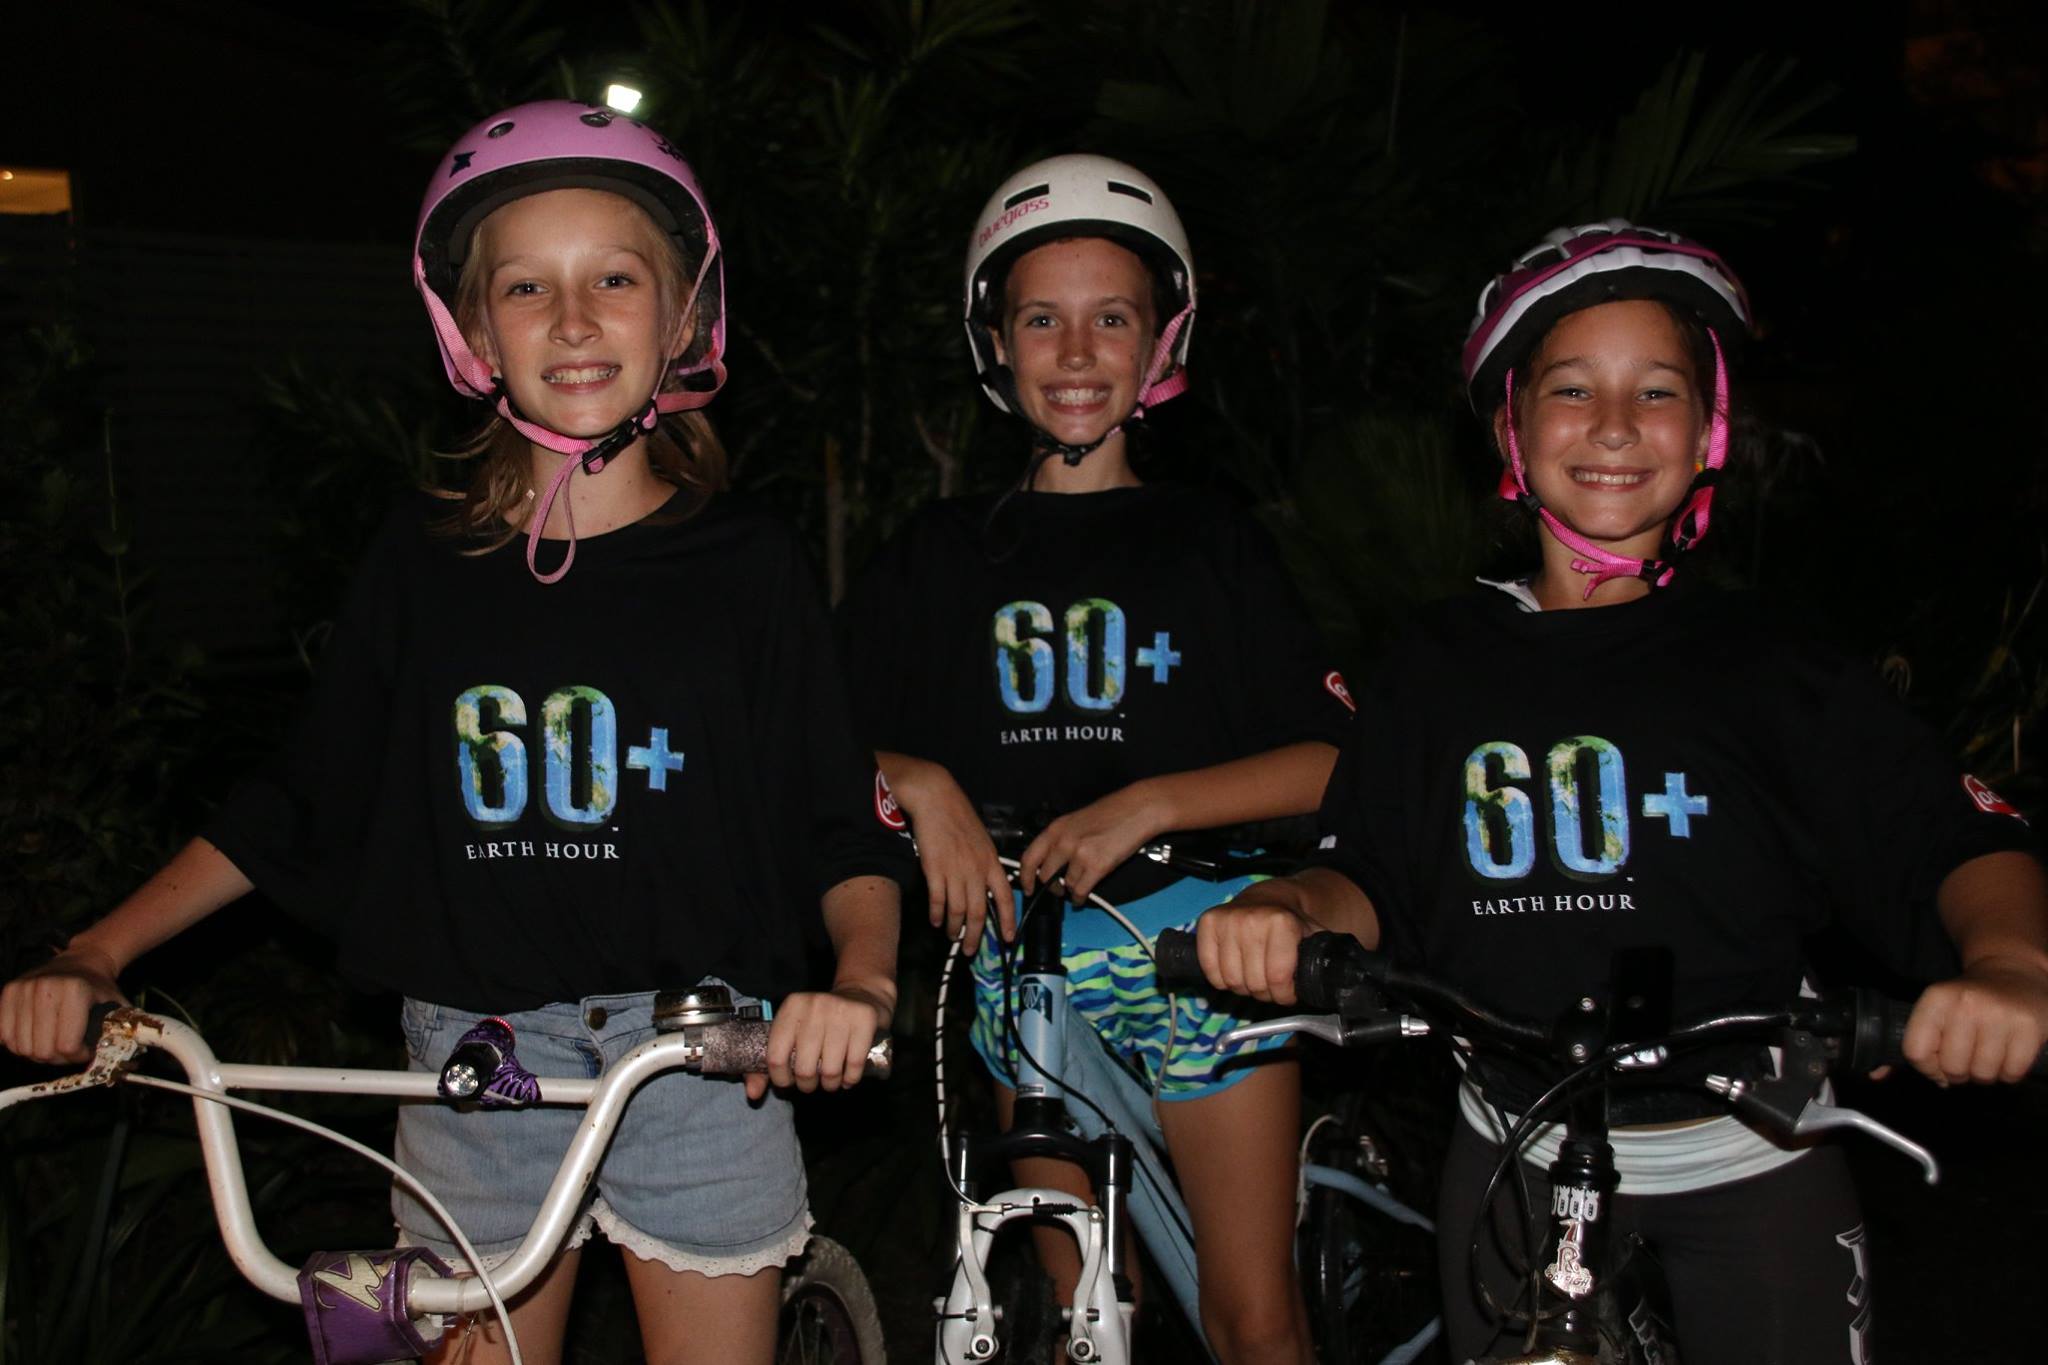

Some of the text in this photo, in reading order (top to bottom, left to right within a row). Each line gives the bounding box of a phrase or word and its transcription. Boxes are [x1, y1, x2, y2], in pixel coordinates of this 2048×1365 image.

[1001, 726, 1124, 744] EARTH HOUR
[465, 841, 620, 860] EARTH HOUR
[1472, 895, 1636, 915] EARTH HOUR
